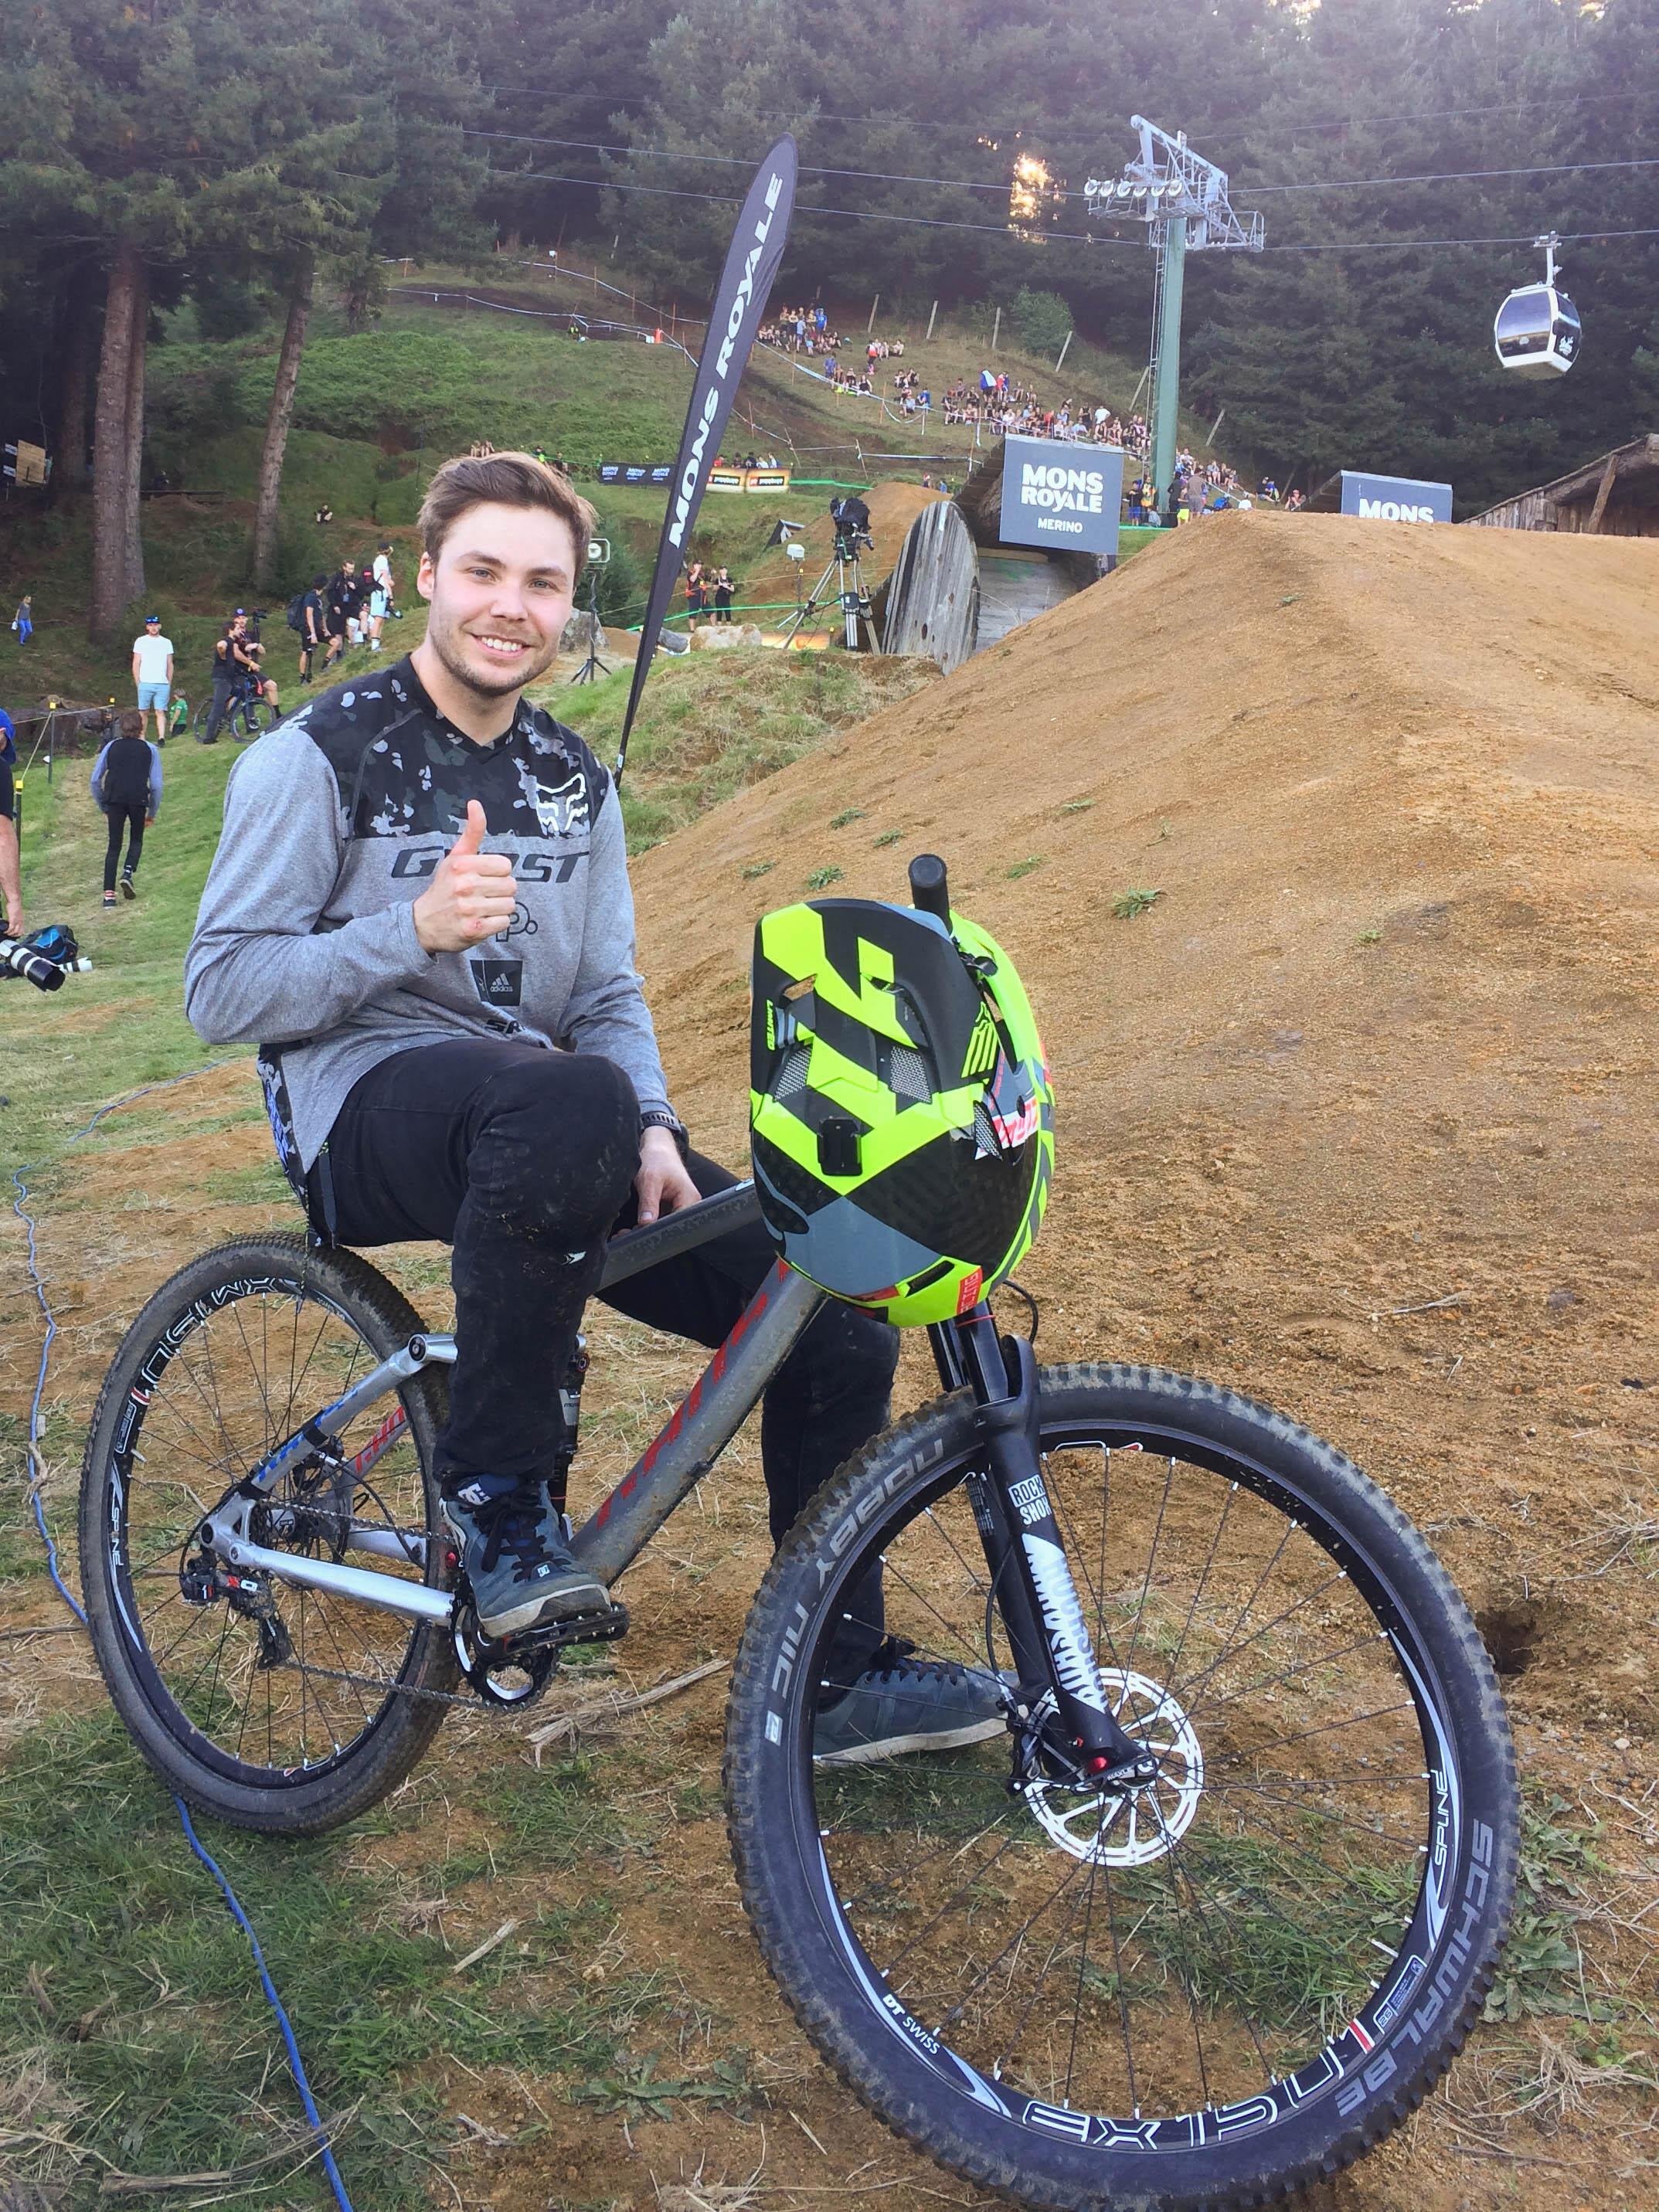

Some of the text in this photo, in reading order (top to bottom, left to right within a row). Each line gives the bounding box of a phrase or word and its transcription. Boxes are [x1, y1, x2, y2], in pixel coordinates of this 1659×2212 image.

[668, 173, 783, 549] MONS ROYALE
[1022, 464, 1103, 494] MONS
[1021, 486, 1103, 514] ROYALE
[1358, 498, 1434, 523] MONS
[1037, 518, 1083, 534] MERINO
[391, 846, 589, 883] GST
[1011, 1476, 1045, 1505] ROCK
[1430, 1768, 1450, 1867] SPLINE
[1334, 1817, 1494, 2117] SCHWALBE
[882, 1993, 940, 2054] DT SWISS
